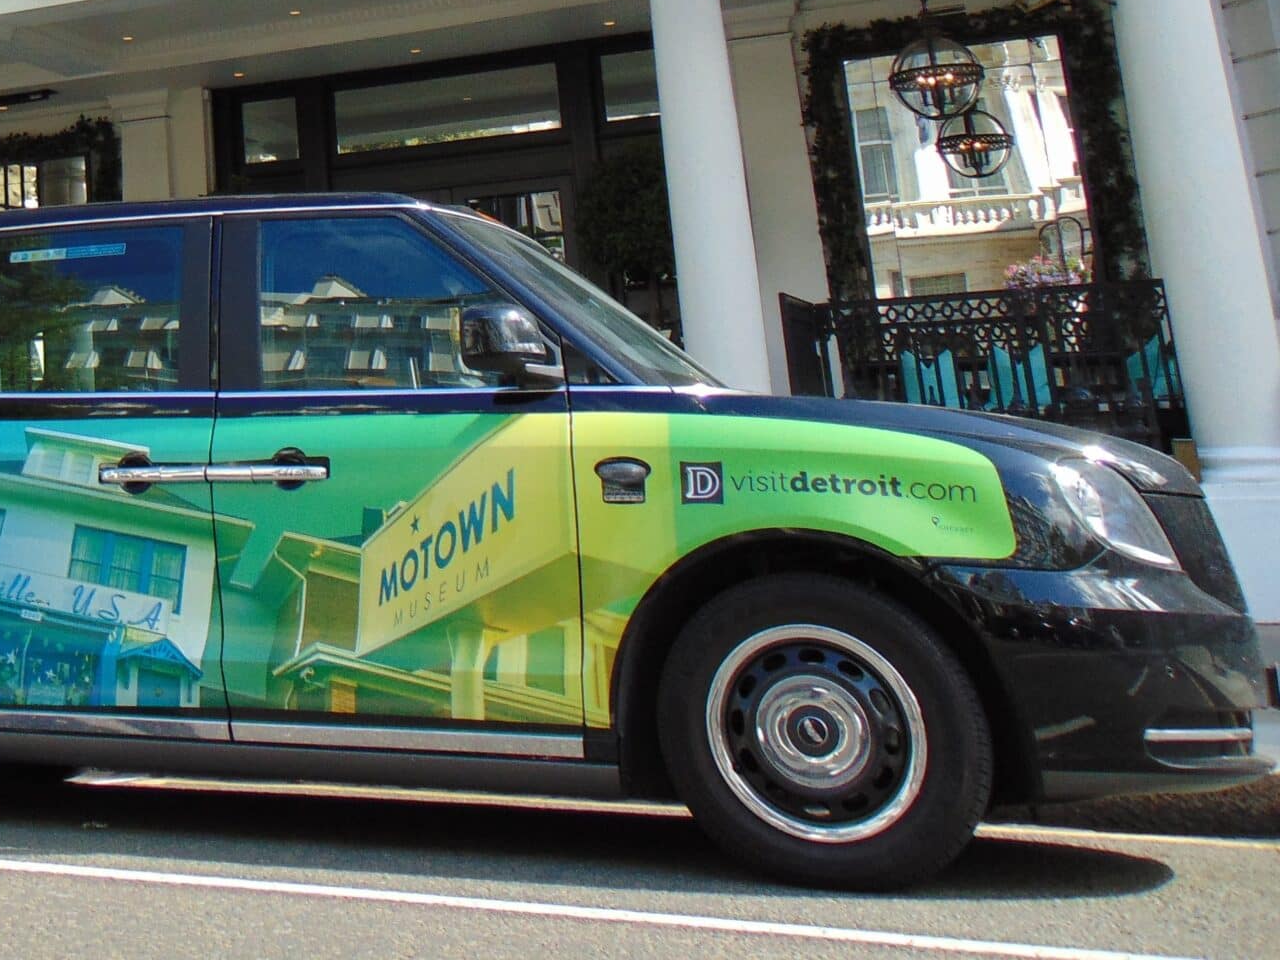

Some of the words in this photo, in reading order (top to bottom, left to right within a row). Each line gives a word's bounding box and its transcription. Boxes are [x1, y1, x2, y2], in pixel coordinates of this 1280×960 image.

[730, 469, 976, 503] visitdetroit.com
[379, 468, 514, 607] MOTOWN
[393, 556, 489, 627] MUSEUM
